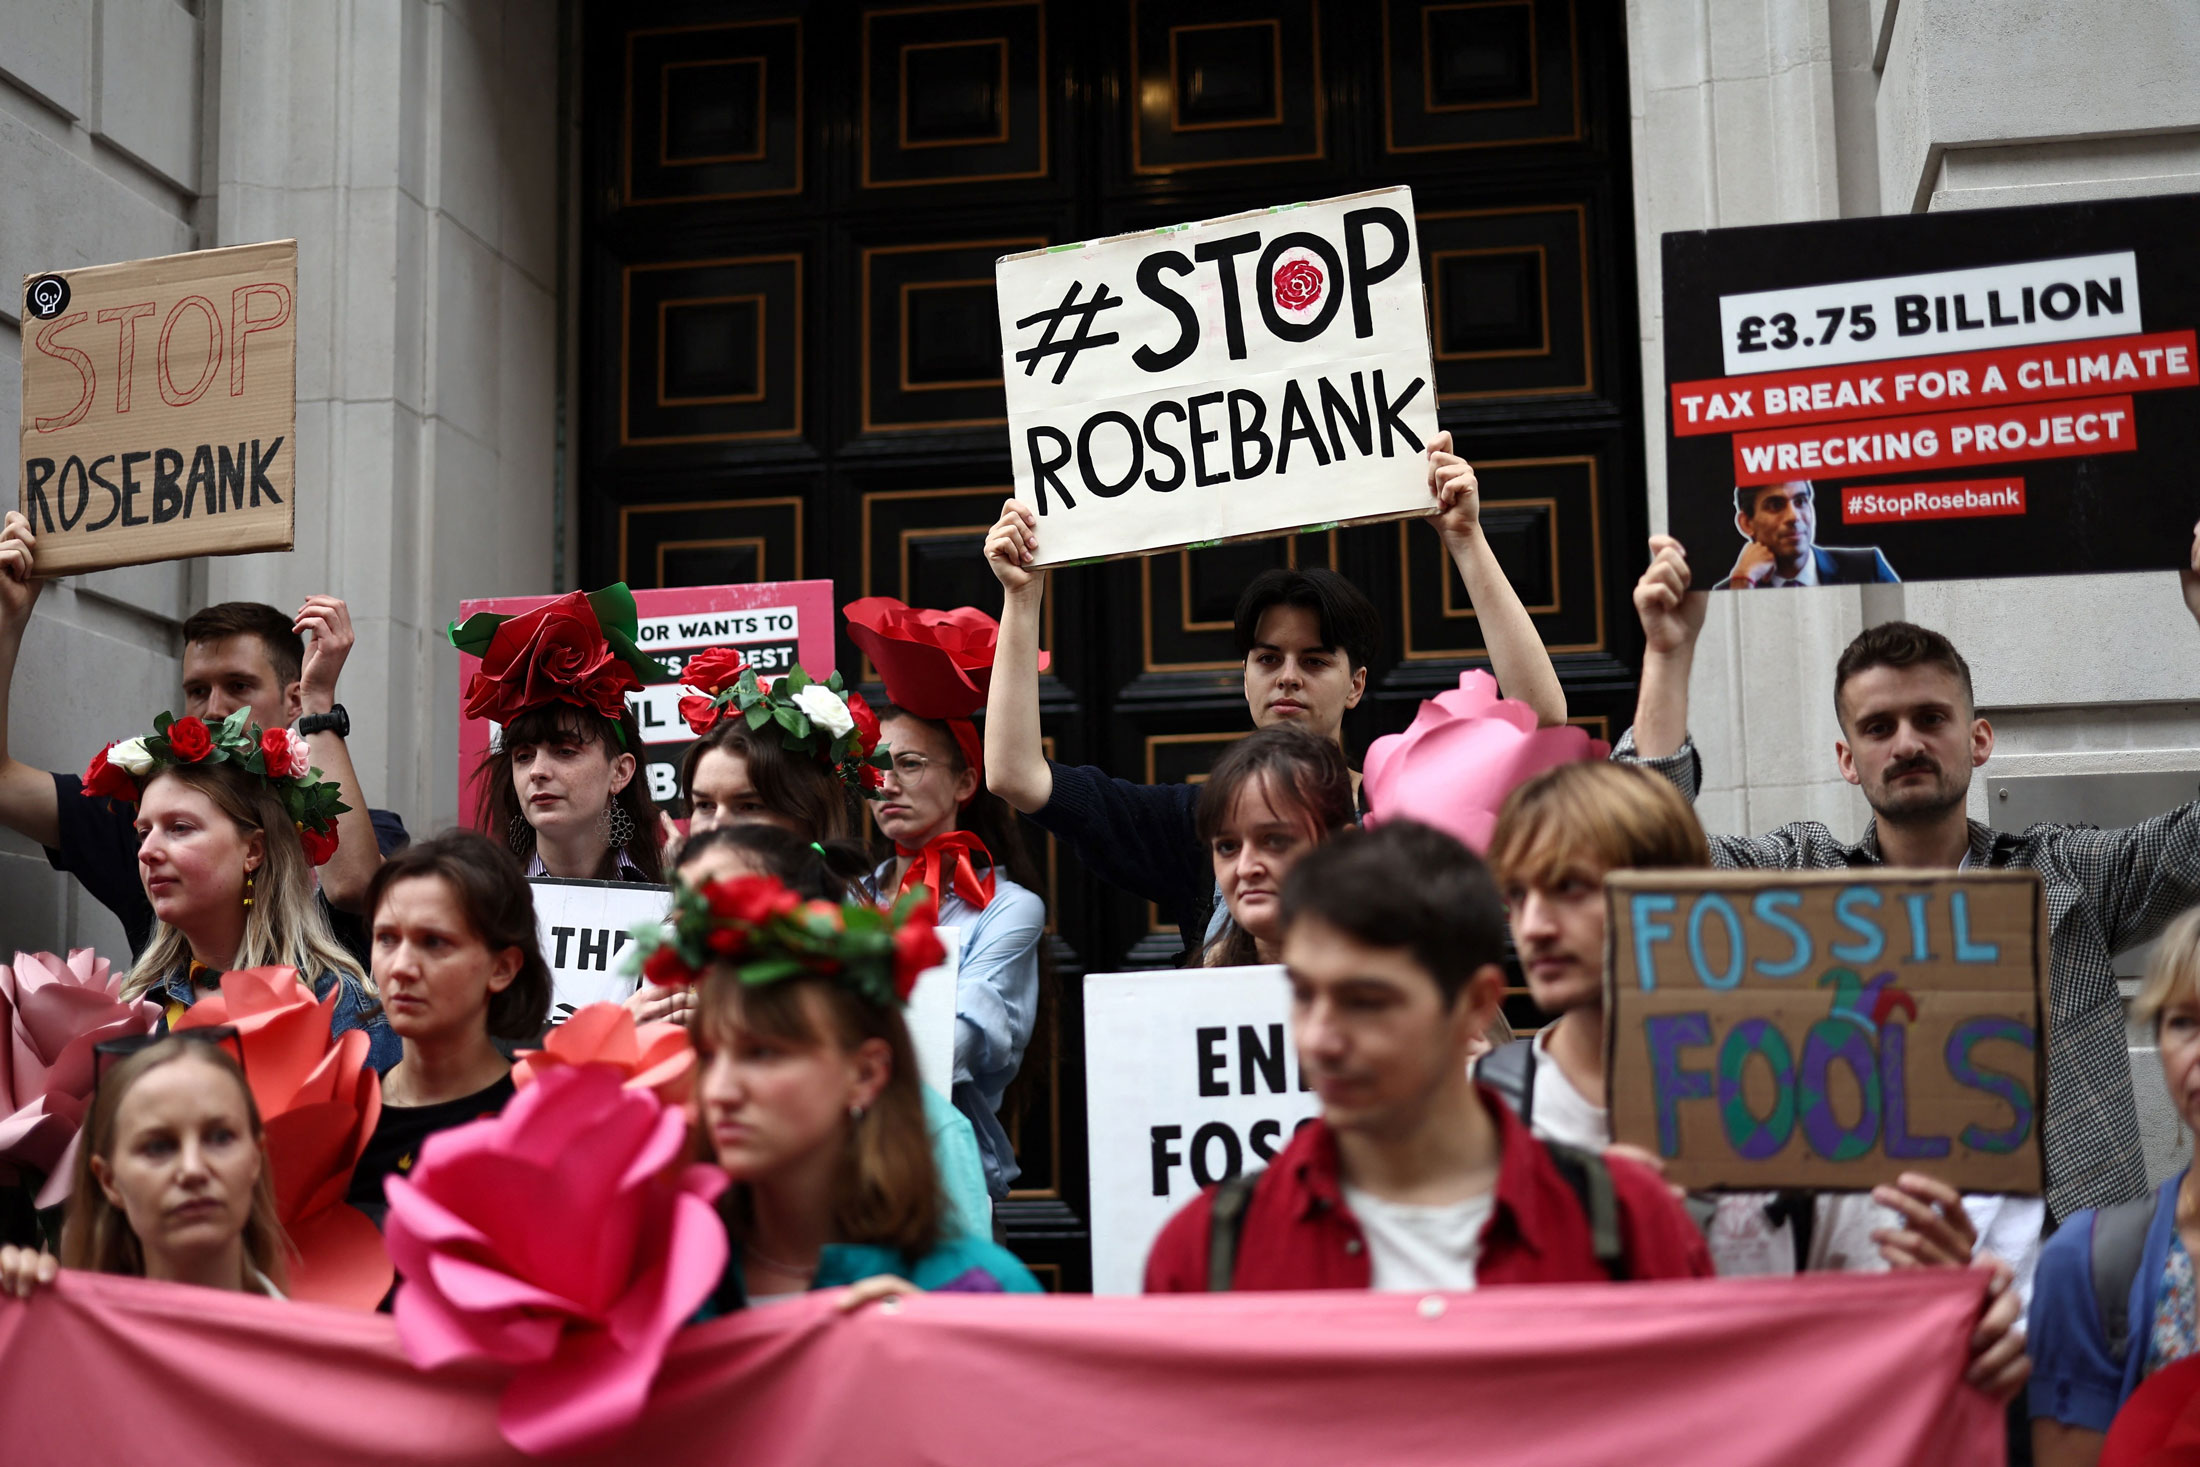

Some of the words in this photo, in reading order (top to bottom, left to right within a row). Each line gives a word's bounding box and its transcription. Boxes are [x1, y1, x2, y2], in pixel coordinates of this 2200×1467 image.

[1015, 206, 1410, 385] #STOP
[1736, 304, 1877, 354] £3.75
[1894, 277, 2125, 336] BILLION
[35, 282, 292, 433] STOP
[1680, 391, 1753, 423] TAX
[1764, 378, 1884, 414] BREAK
[1894, 369, 1970, 401] FOR
[1981, 365, 2007, 393] A
[2017, 346, 2190, 388] CLIMATE
[1026, 369, 1426, 517] ROSEBANK
[1740, 430, 1939, 473] WRECKING
[1950, 411, 2126, 453] PROJECT
[25, 436, 285, 536] ROSEBANK
[1847, 487, 2020, 515] #StopRosebank
[639, 625, 670, 641] OR
[678, 617, 758, 639] WANTS
[764, 614, 794, 631] TO
[1630, 886, 1999, 993] FOSSIL
[1196, 1023, 1312, 1097] EN
[1643, 1010, 2038, 1162] FOOLS
[1150, 1116, 1318, 1197] FOS
